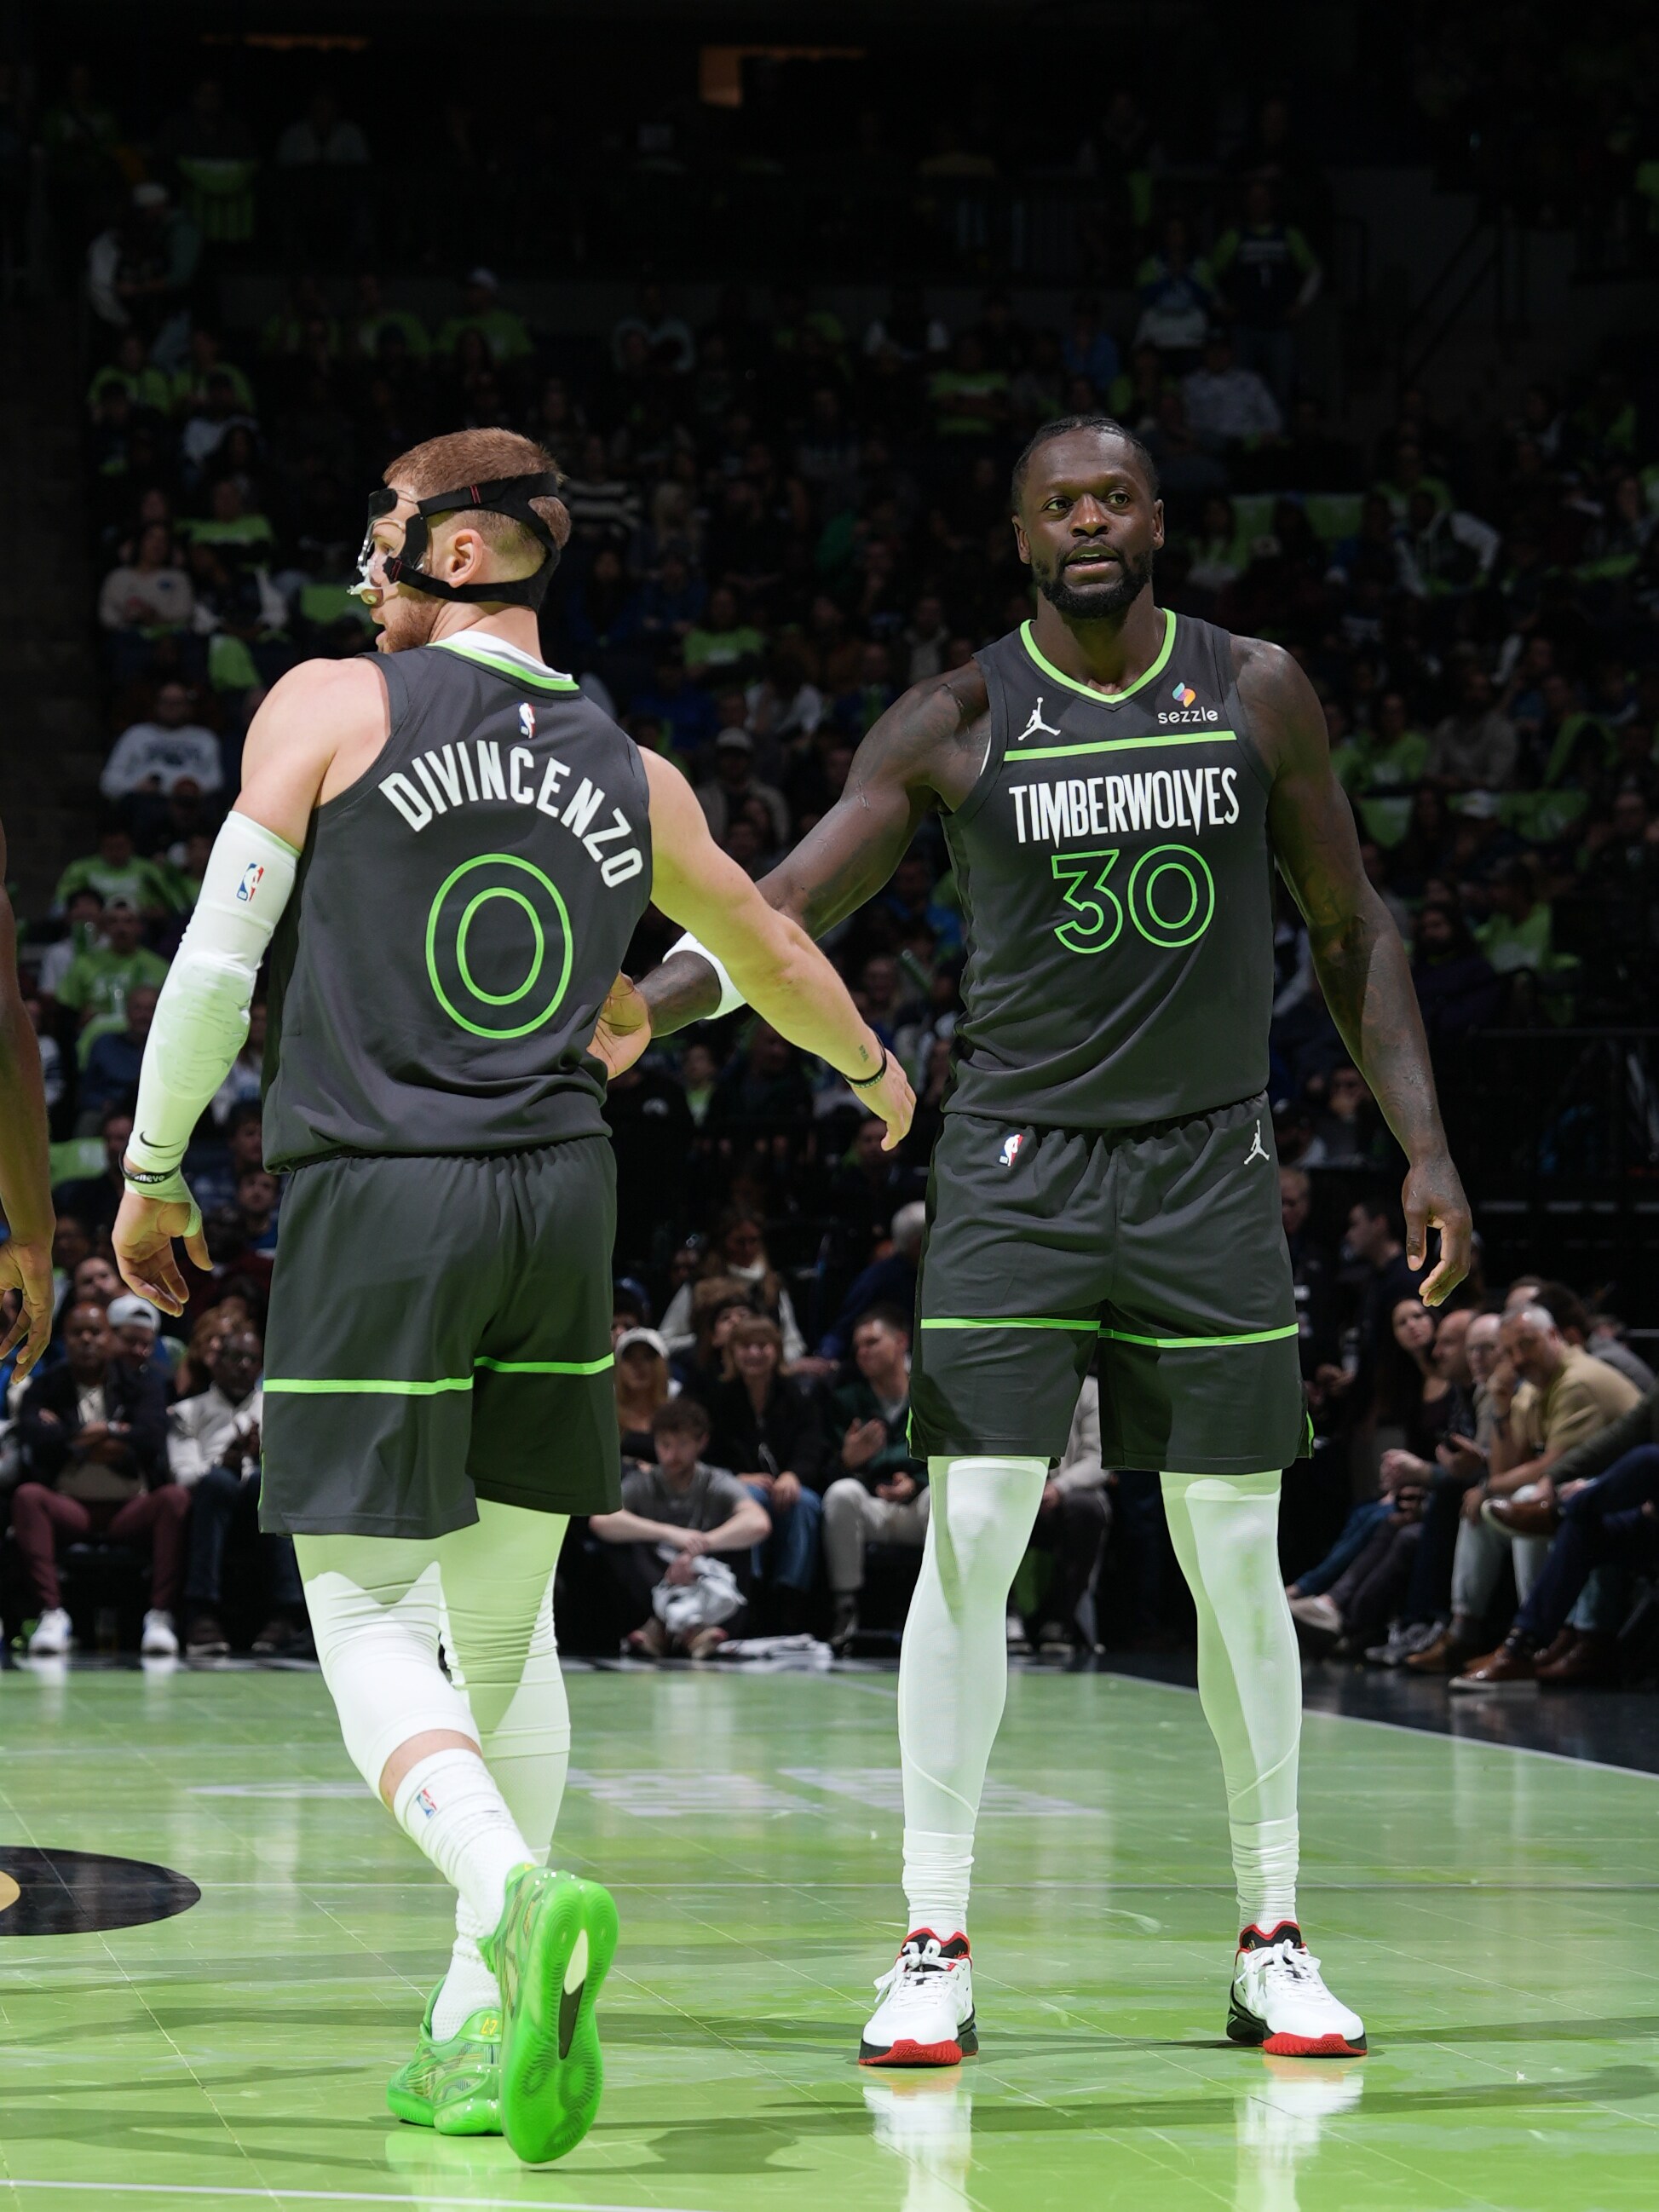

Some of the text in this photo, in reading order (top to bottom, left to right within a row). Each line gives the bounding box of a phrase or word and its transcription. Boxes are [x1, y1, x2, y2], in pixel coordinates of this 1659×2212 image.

[1157, 706, 1218, 724] sezzle
[378, 740, 643, 888] DIVINCENZO
[1009, 767, 1240, 849] TIMBERWOLVES
[426, 853, 573, 1040] 0
[1051, 844, 1215, 954] 30
